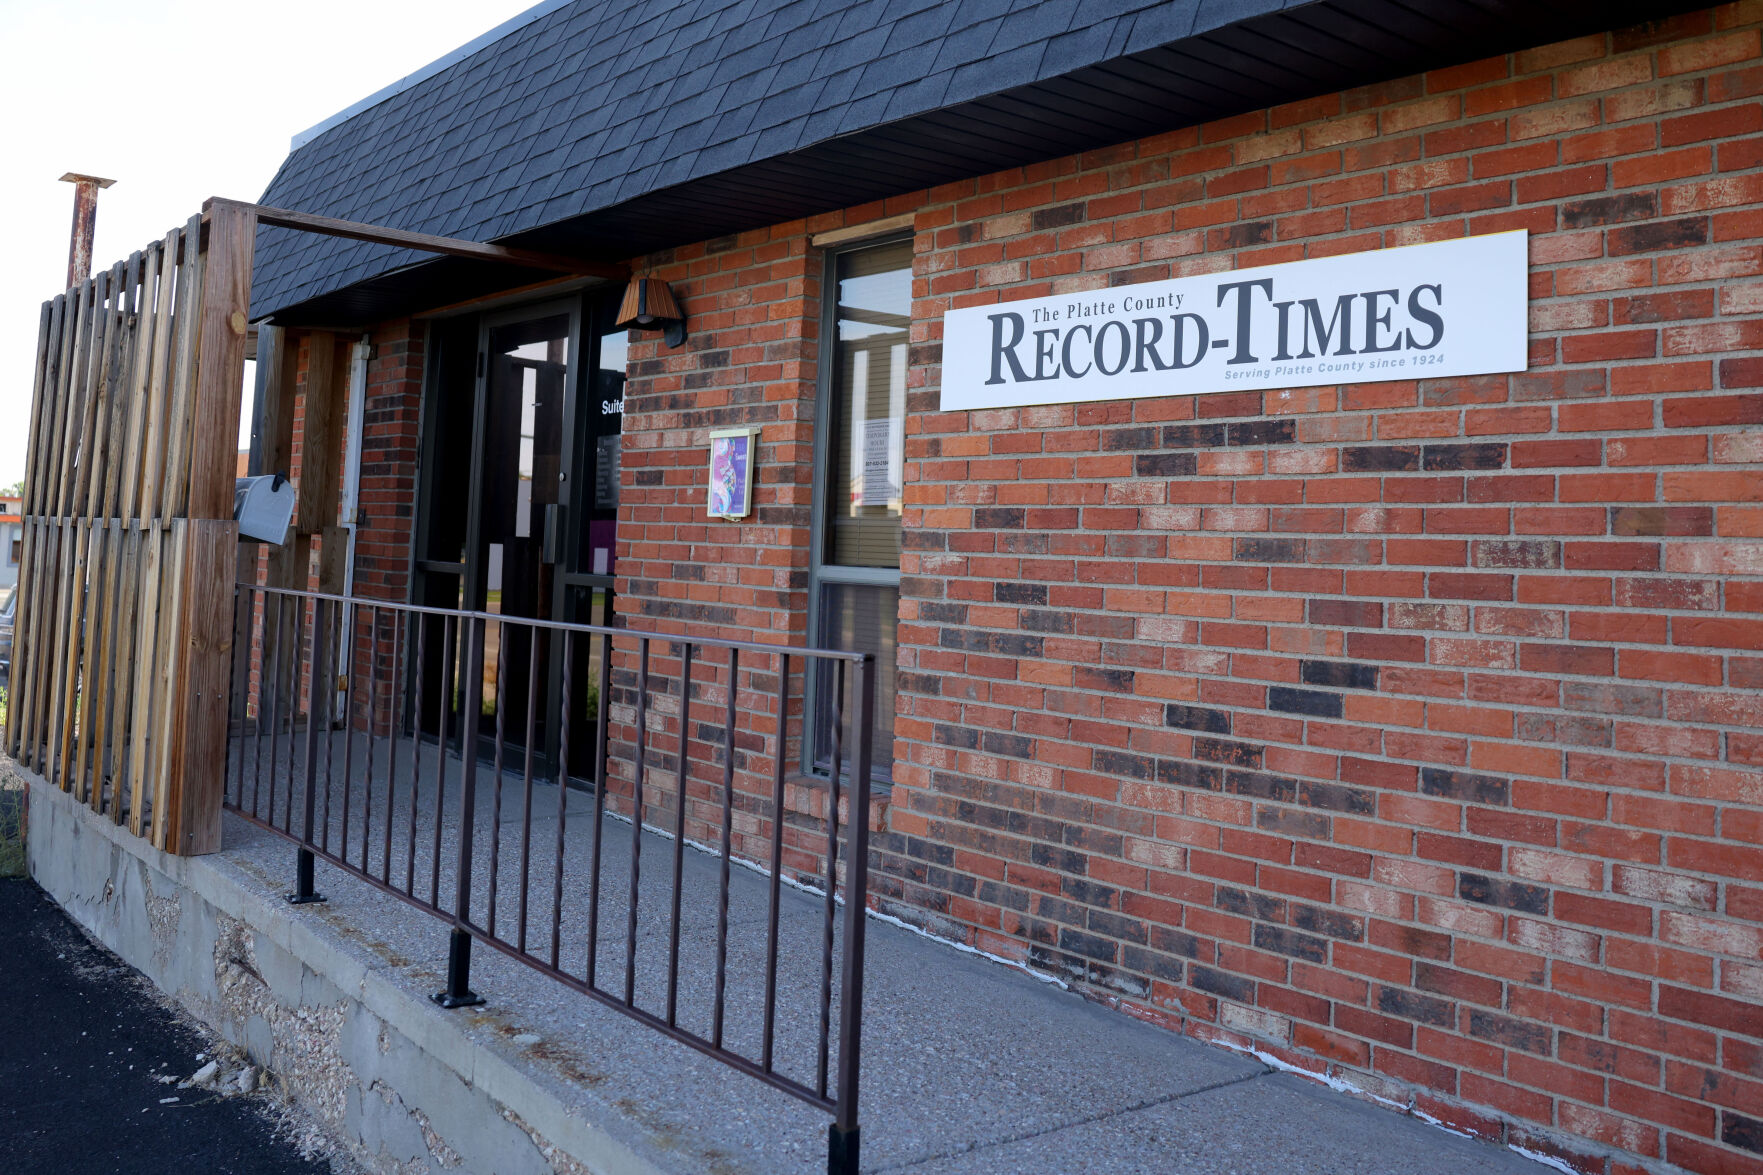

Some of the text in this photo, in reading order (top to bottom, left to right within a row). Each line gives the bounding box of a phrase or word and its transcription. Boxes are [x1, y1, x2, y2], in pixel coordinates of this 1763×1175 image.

[1032, 292, 1184, 323] The Platte County
[985, 278, 1444, 385] RECORD-TIMES
[1224, 354, 1444, 380] Serving Platte County since 1924
[601, 399, 625, 415] Suite
